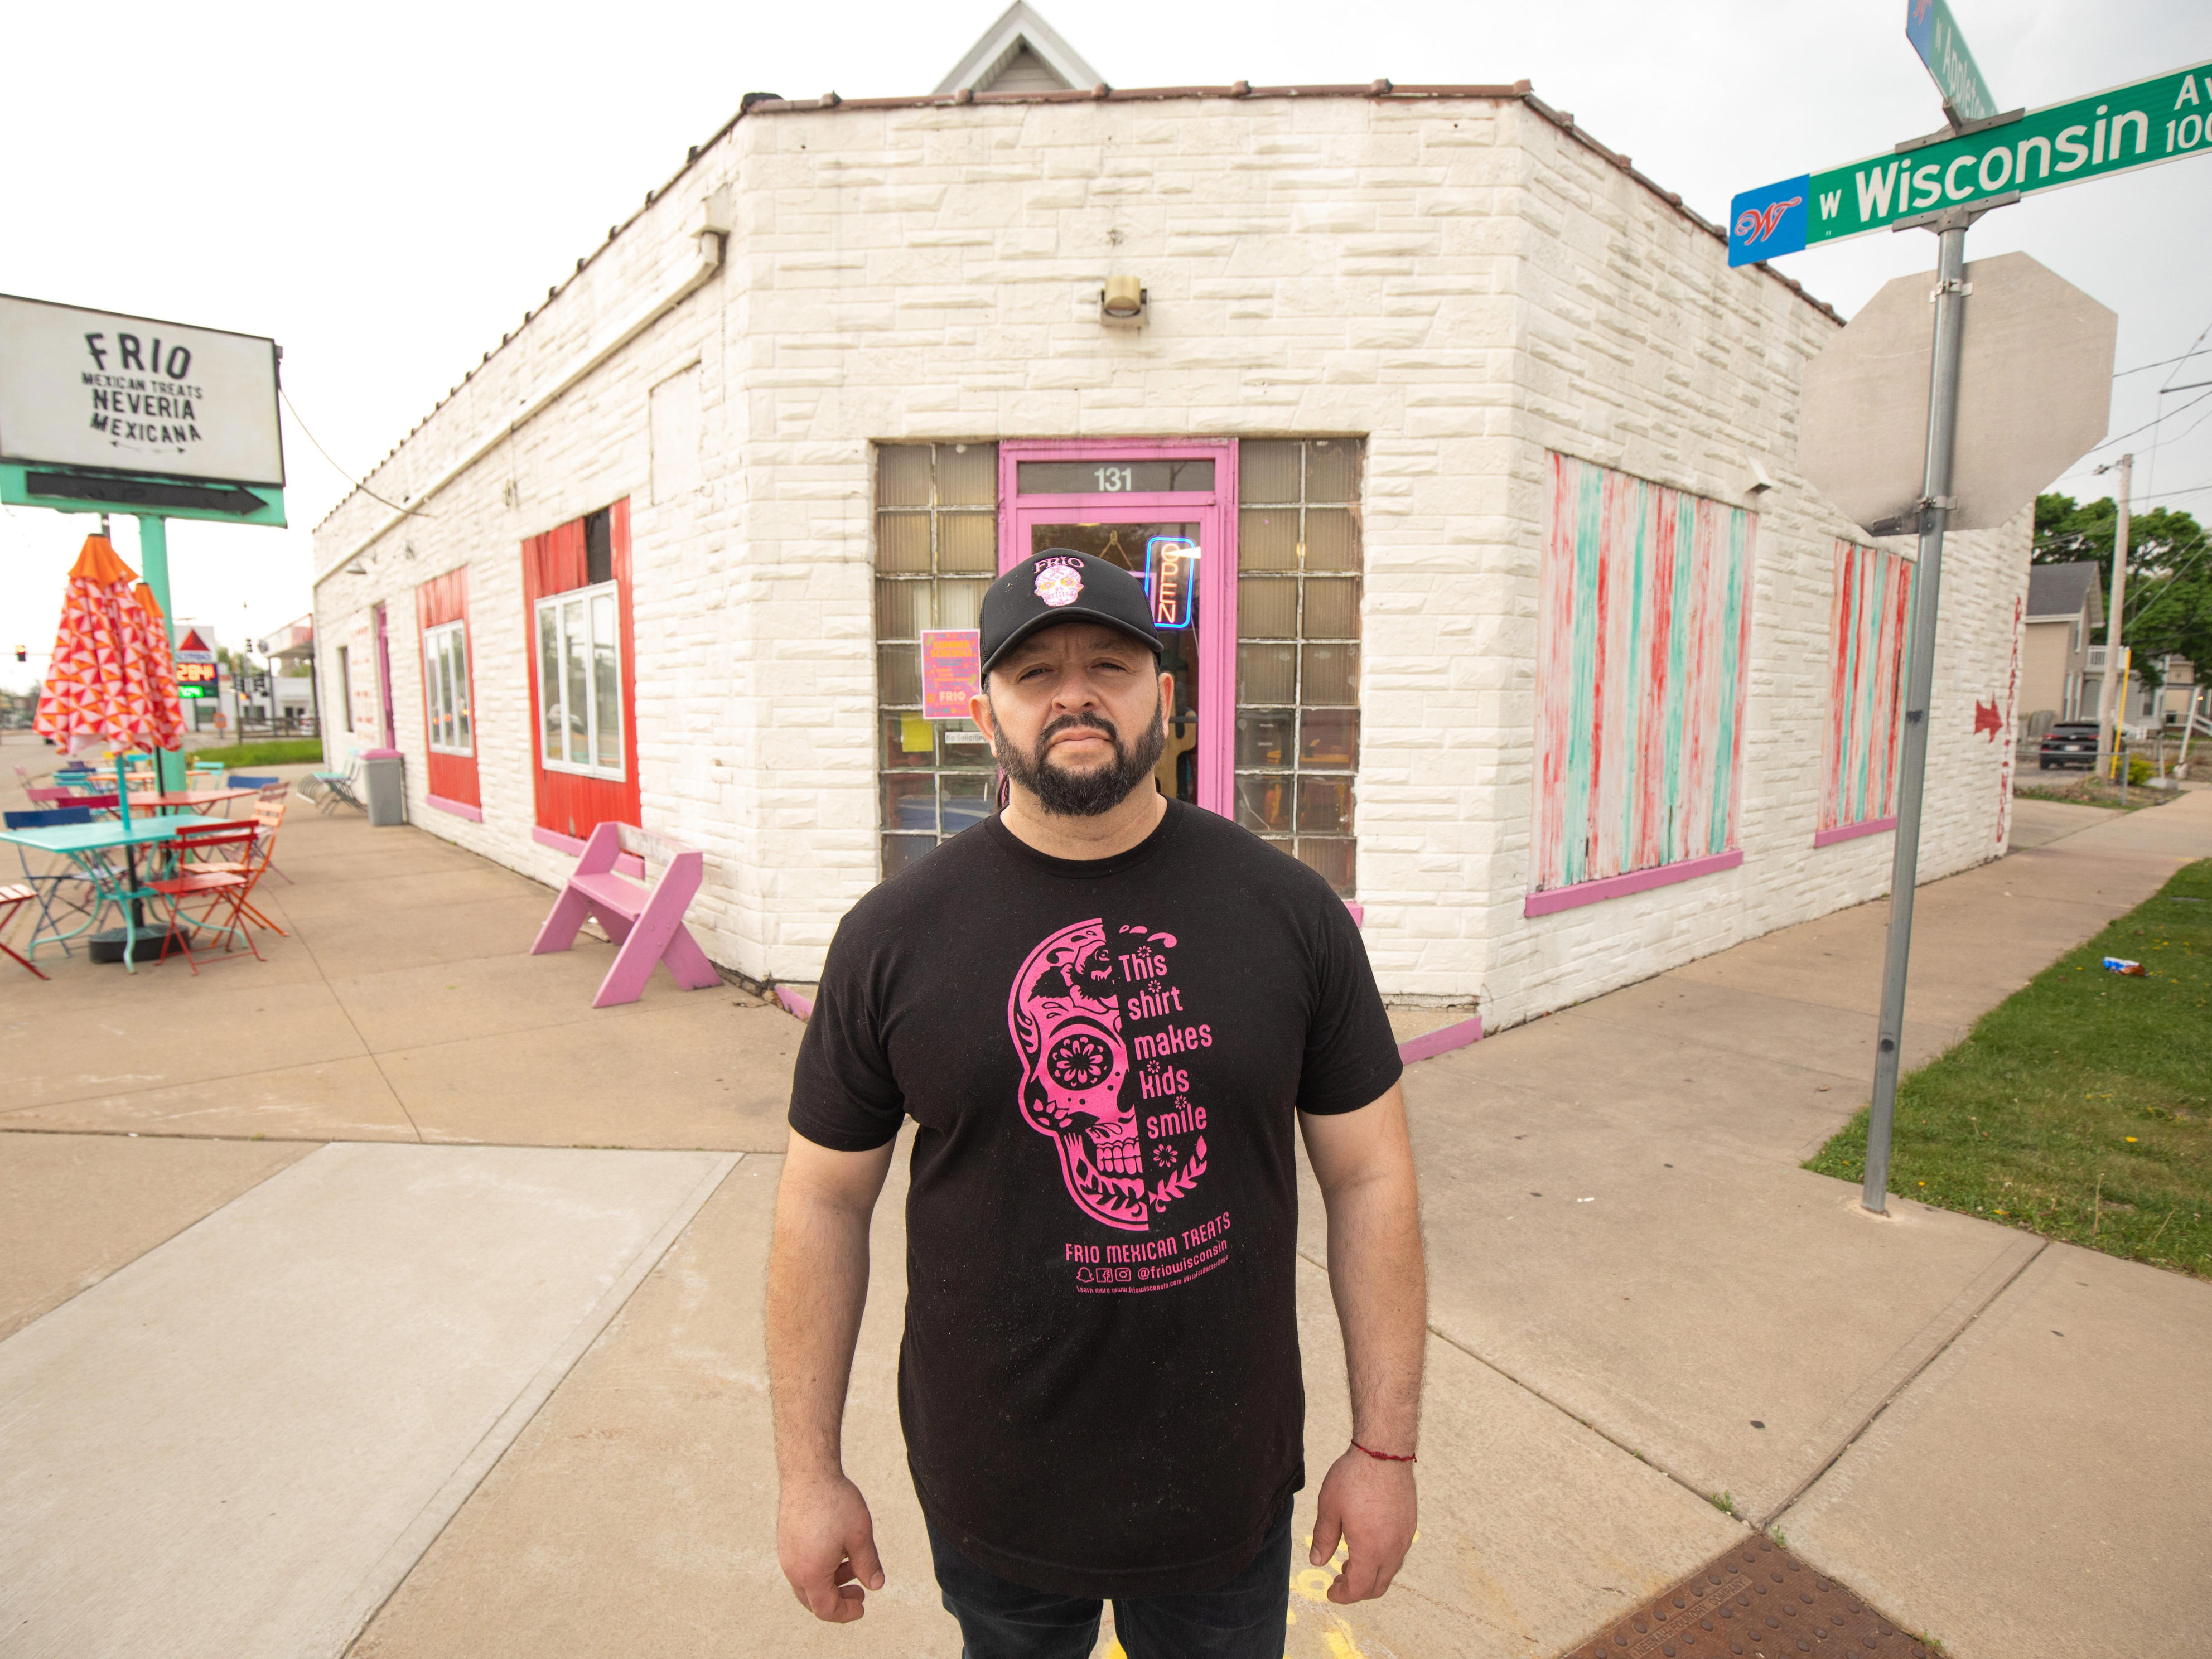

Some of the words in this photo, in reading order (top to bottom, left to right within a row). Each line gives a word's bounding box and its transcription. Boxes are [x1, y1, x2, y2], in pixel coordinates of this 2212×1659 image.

[1936, 17, 1943, 54] N
[1819, 189, 1842, 220] W
[1855, 104, 2149, 223] Wisconsin
[85, 332, 191, 380] FRIO
[81, 372, 146, 391] MEXICAN
[151, 380, 203, 399] TREATS
[92, 389, 197, 420] NEVERIA
[90, 413, 202, 443] MEXICANA
[1094, 467, 1132, 492] 131
[1157, 543, 1181, 624] OPEN
[1118, 951, 1167, 982] This
[1127, 986, 1184, 1020] shirt
[1134, 1024, 1213, 1060] makes
[1139, 1065, 1190, 1099] kids
[1146, 1103, 1207, 1139] smile
[1065, 1243, 1100, 1264] FRIO
[1106, 1236, 1178, 1263] MEXICAN
[1181, 1211, 1231, 1250] TREATS
[1076, 1285, 1094, 1294] Learn
[1111, 1279, 1182, 1294] www.friowisconsin.com
[1184, 1254, 1229, 1283] #FrioForBetterDays
[1137, 1239, 1228, 1280] @friowisconsin
[1634, 1627, 1670, 1655] NEENAH
[1669, 1603, 1709, 1632] FOUNDRY
[1708, 1579, 1746, 1605] COMPANY
